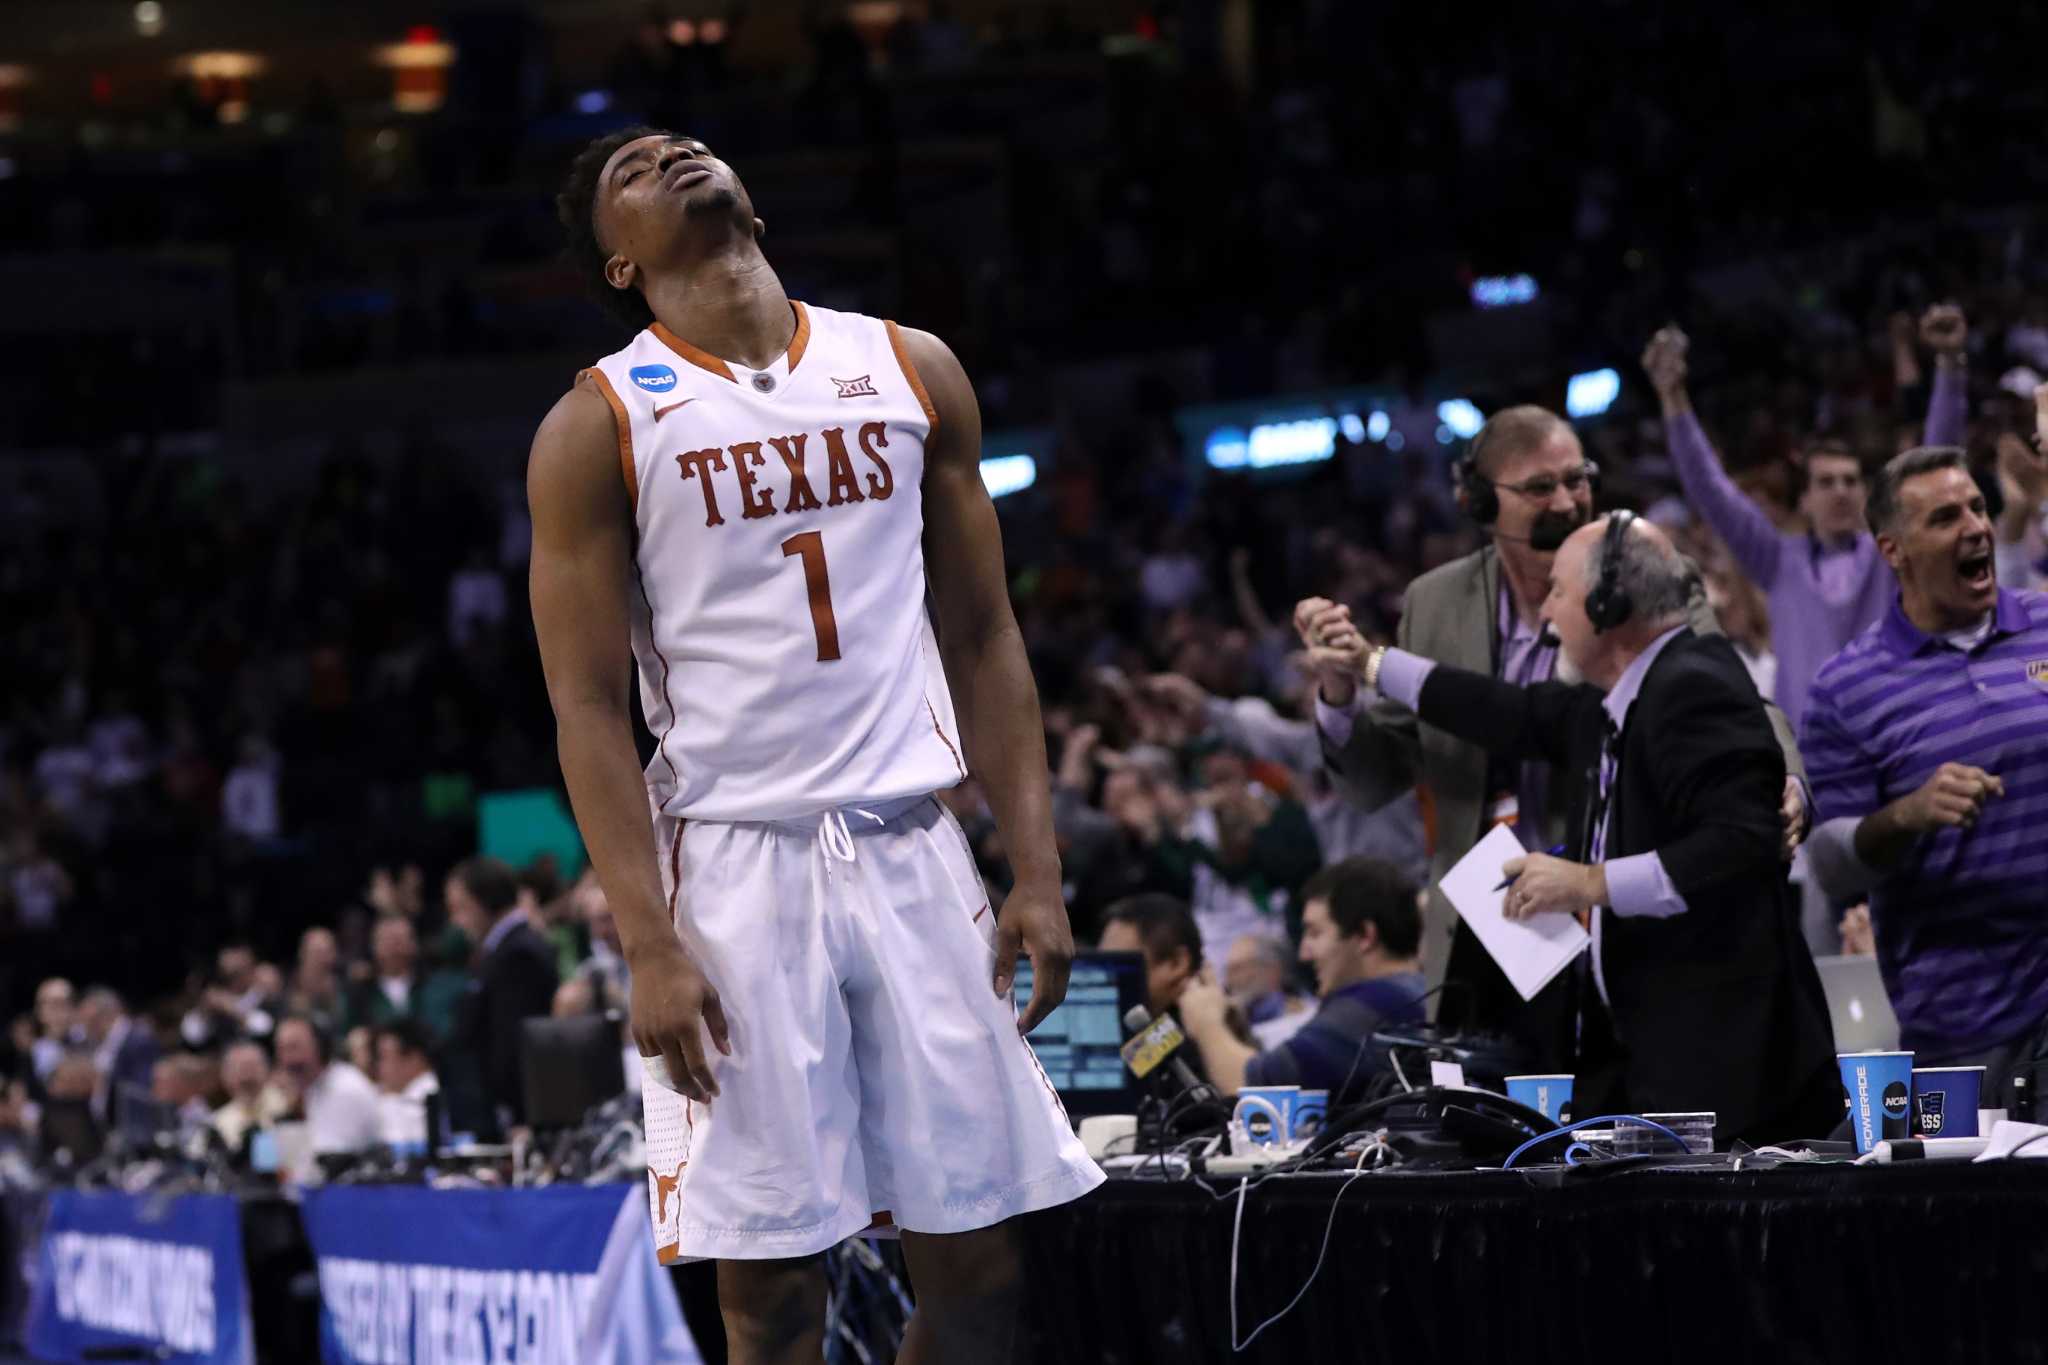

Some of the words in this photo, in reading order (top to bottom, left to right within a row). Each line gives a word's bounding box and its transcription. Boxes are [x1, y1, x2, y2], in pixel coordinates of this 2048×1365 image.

[637, 374, 673, 386] NCAA
[675, 421, 895, 528] TEXAS
[781, 530, 841, 662] 1
[1856, 1064, 1873, 1151] POWERADE
